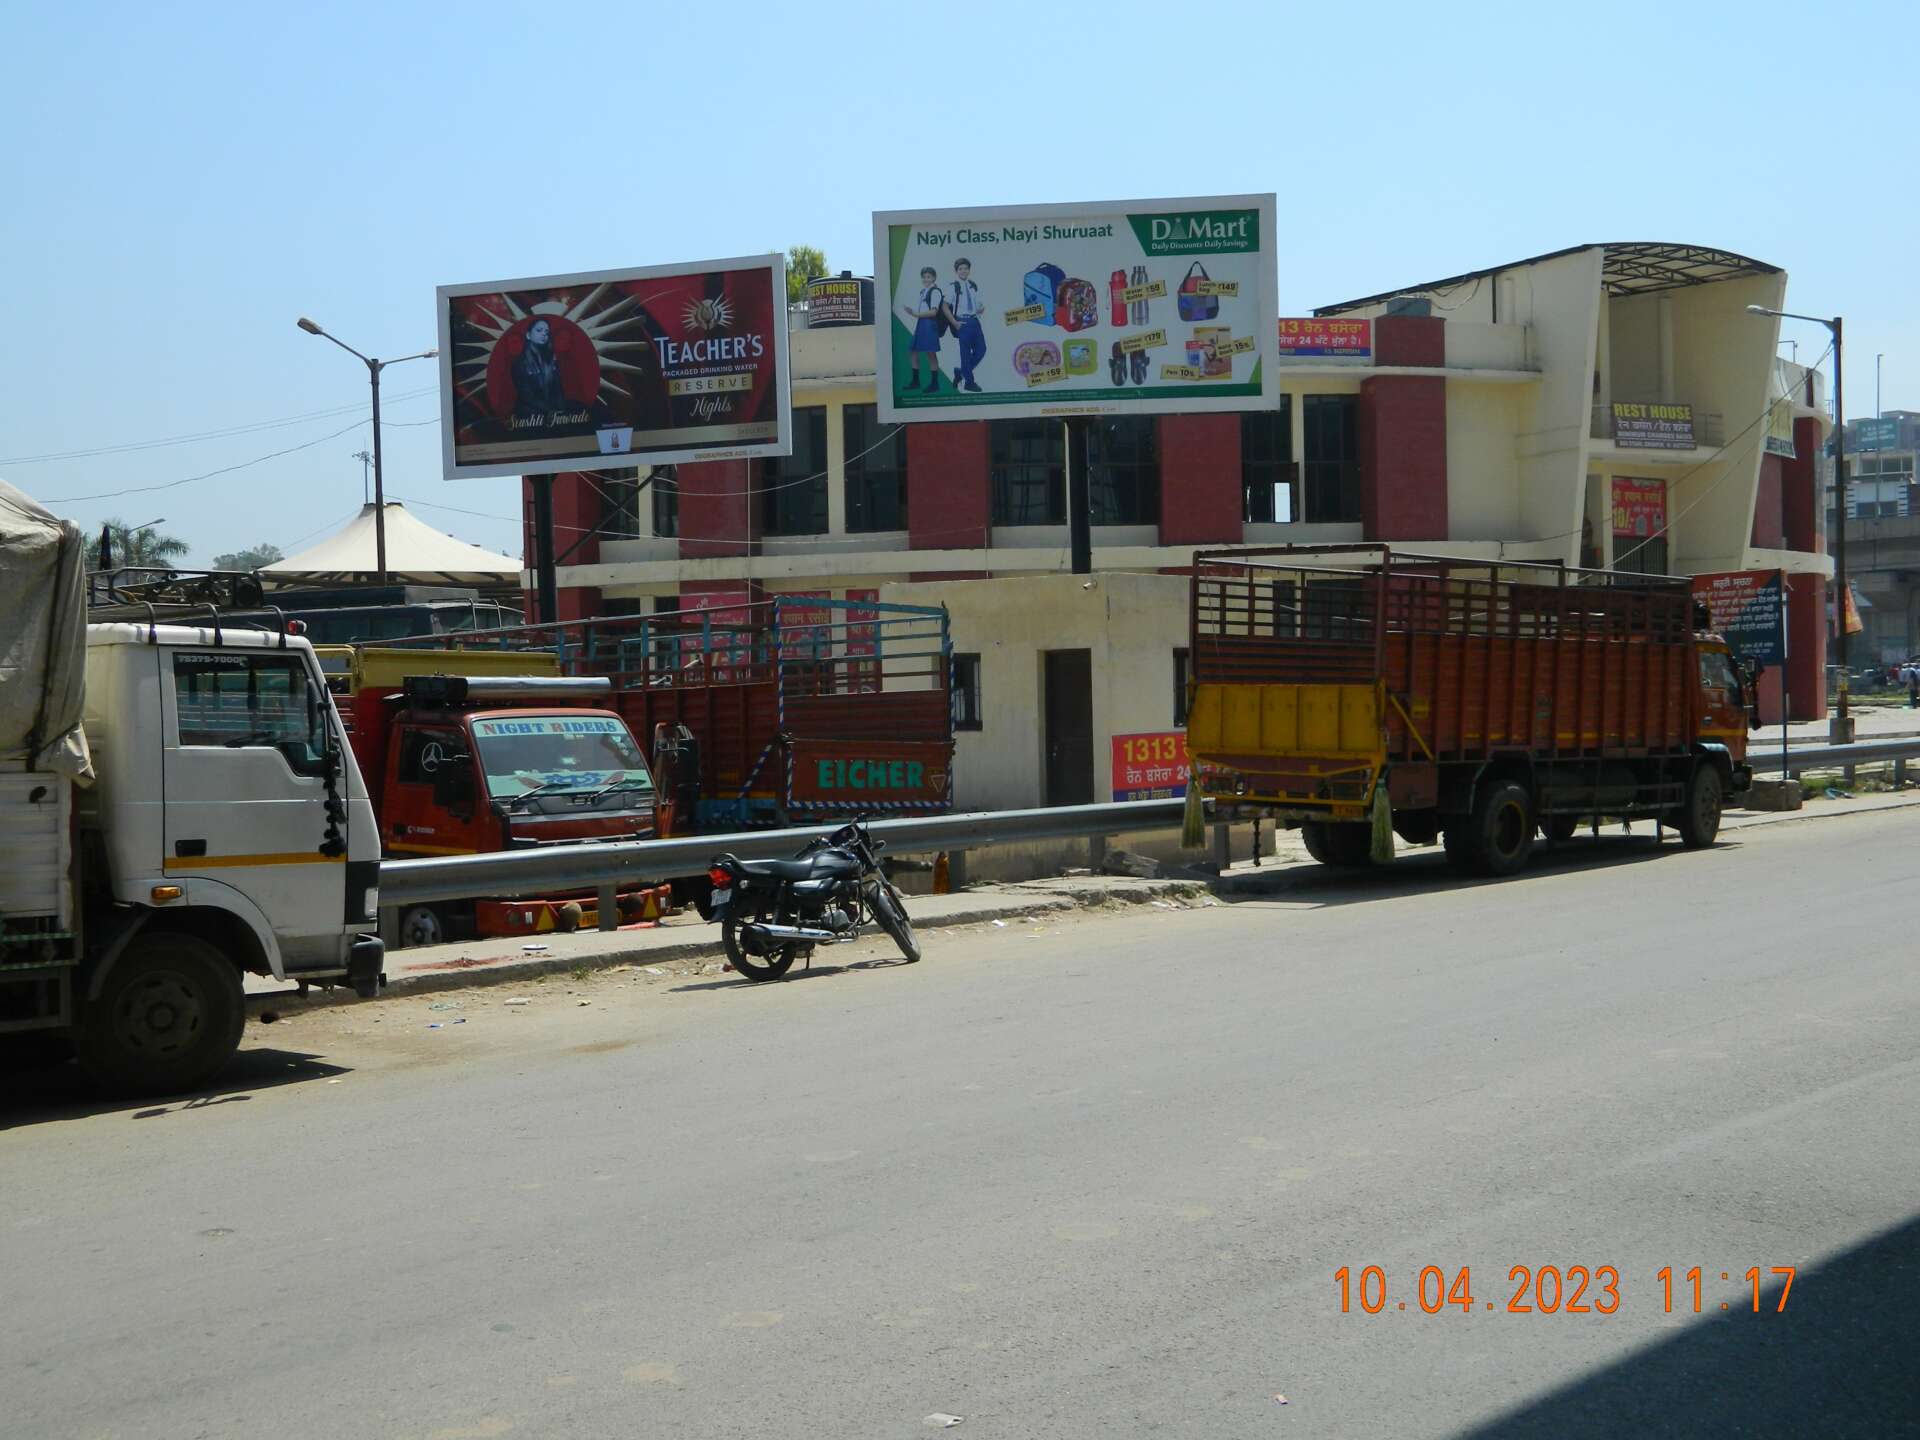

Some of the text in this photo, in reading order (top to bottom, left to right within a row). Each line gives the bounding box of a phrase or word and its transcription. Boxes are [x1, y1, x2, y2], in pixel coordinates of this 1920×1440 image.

[917, 222, 1113, 248] Nayi Class, Nayi Shuruaat
[826, 283, 857, 294] HOUSE
[1299, 336, 1312, 345] 24
[653, 333, 764, 369] TEACHER'S
[662, 368, 699, 377] PACKAGED
[673, 376, 749, 393] RESERVE
[689, 395, 733, 422] Nights
[1613, 402, 1692, 420] REST HOUSE
[481, 720, 617, 736] NIGHT RIDERS
[1123, 736, 1177, 763] 1313
[817, 759, 924, 789] EICHER
